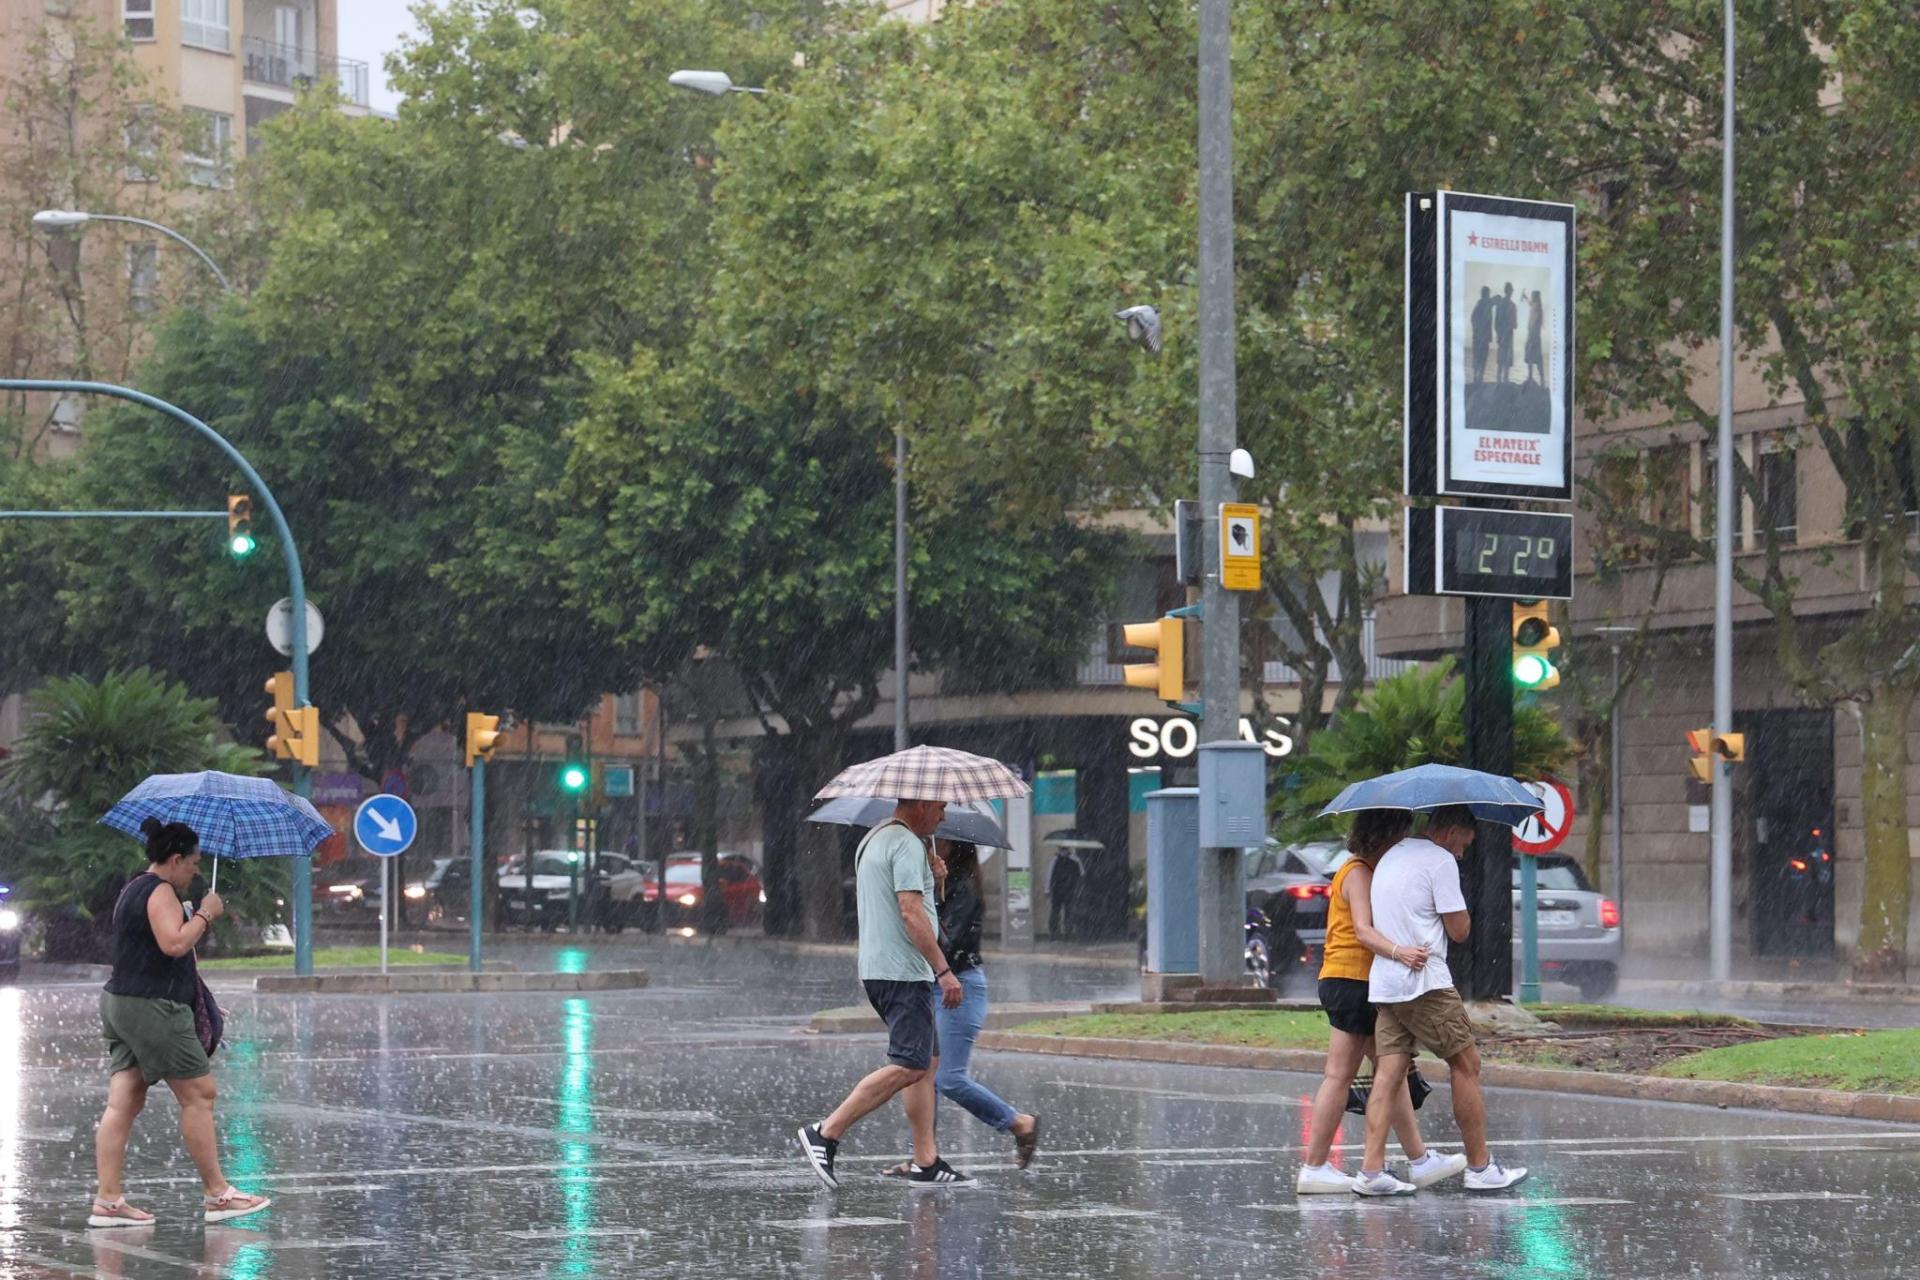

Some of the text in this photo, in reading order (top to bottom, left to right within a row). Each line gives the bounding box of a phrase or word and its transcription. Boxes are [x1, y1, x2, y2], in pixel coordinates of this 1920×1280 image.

[1479, 436, 1537, 451] EL MATEIX
[1474, 450, 1542, 465] ESPECTACLE
[1128, 717, 1293, 758] SOS
